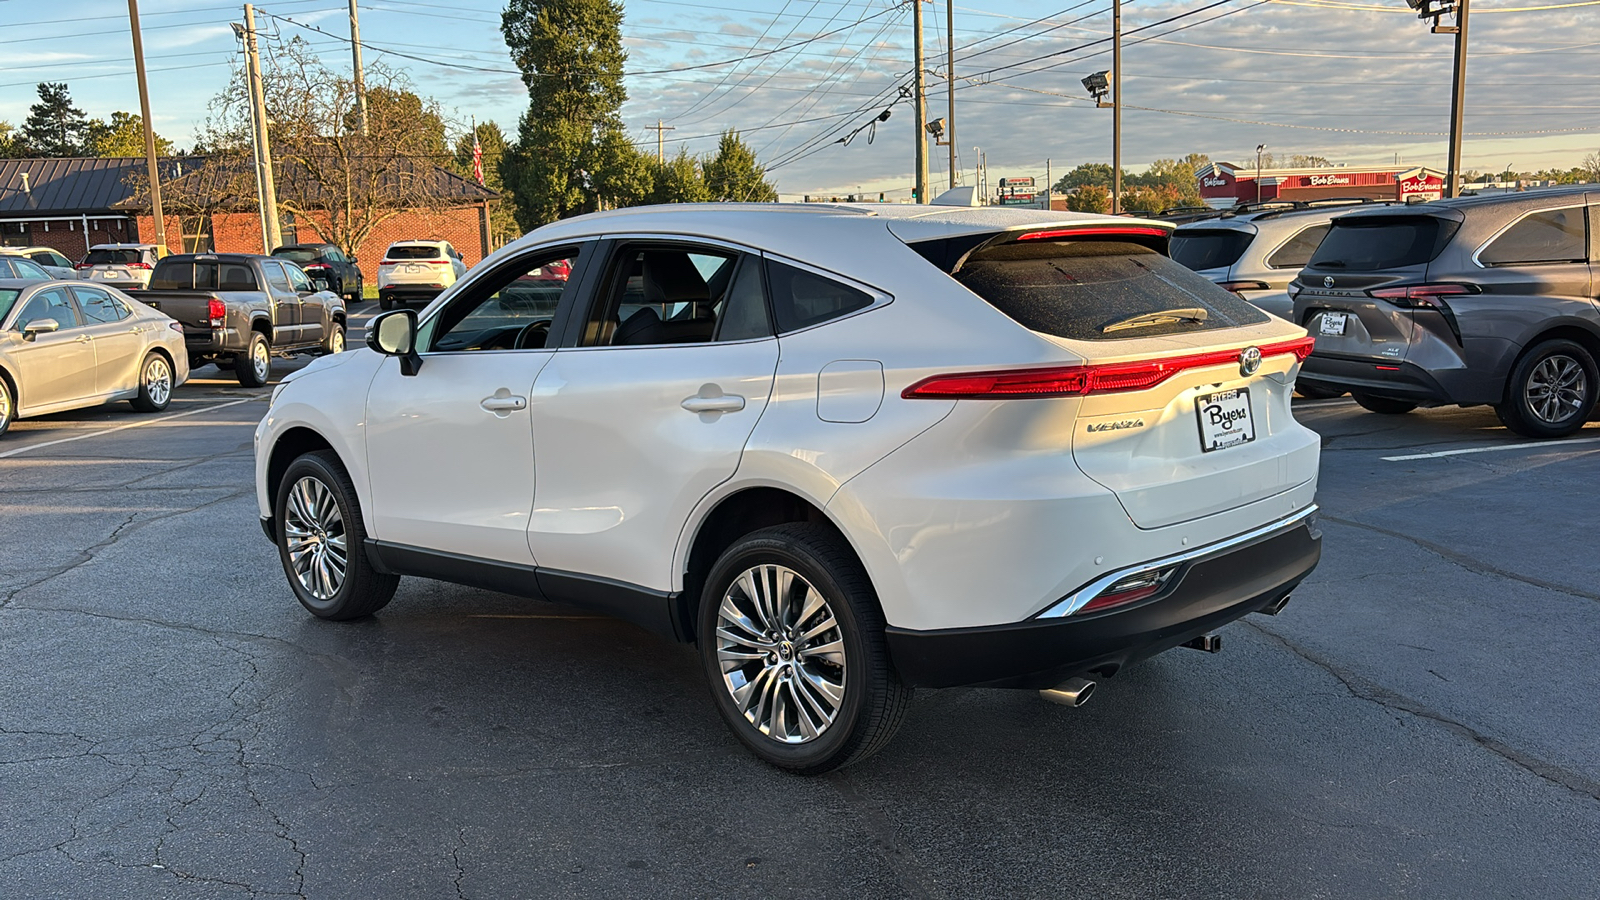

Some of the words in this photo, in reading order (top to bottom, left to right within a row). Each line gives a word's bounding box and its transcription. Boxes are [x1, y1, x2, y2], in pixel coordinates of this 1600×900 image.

[1204, 178, 1212, 187] Bob
[1212, 177, 1226, 186] Evans
[1310, 176, 1327, 185] Bob
[1327, 175, 1349, 184] Evans
[1402, 182, 1418, 192] Bob
[1418, 181, 1440, 191] Evans
[1211, 389, 1237, 402] BYERS
[1203, 405, 1246, 430] Byers
[1087, 419, 1143, 432] VENZA
